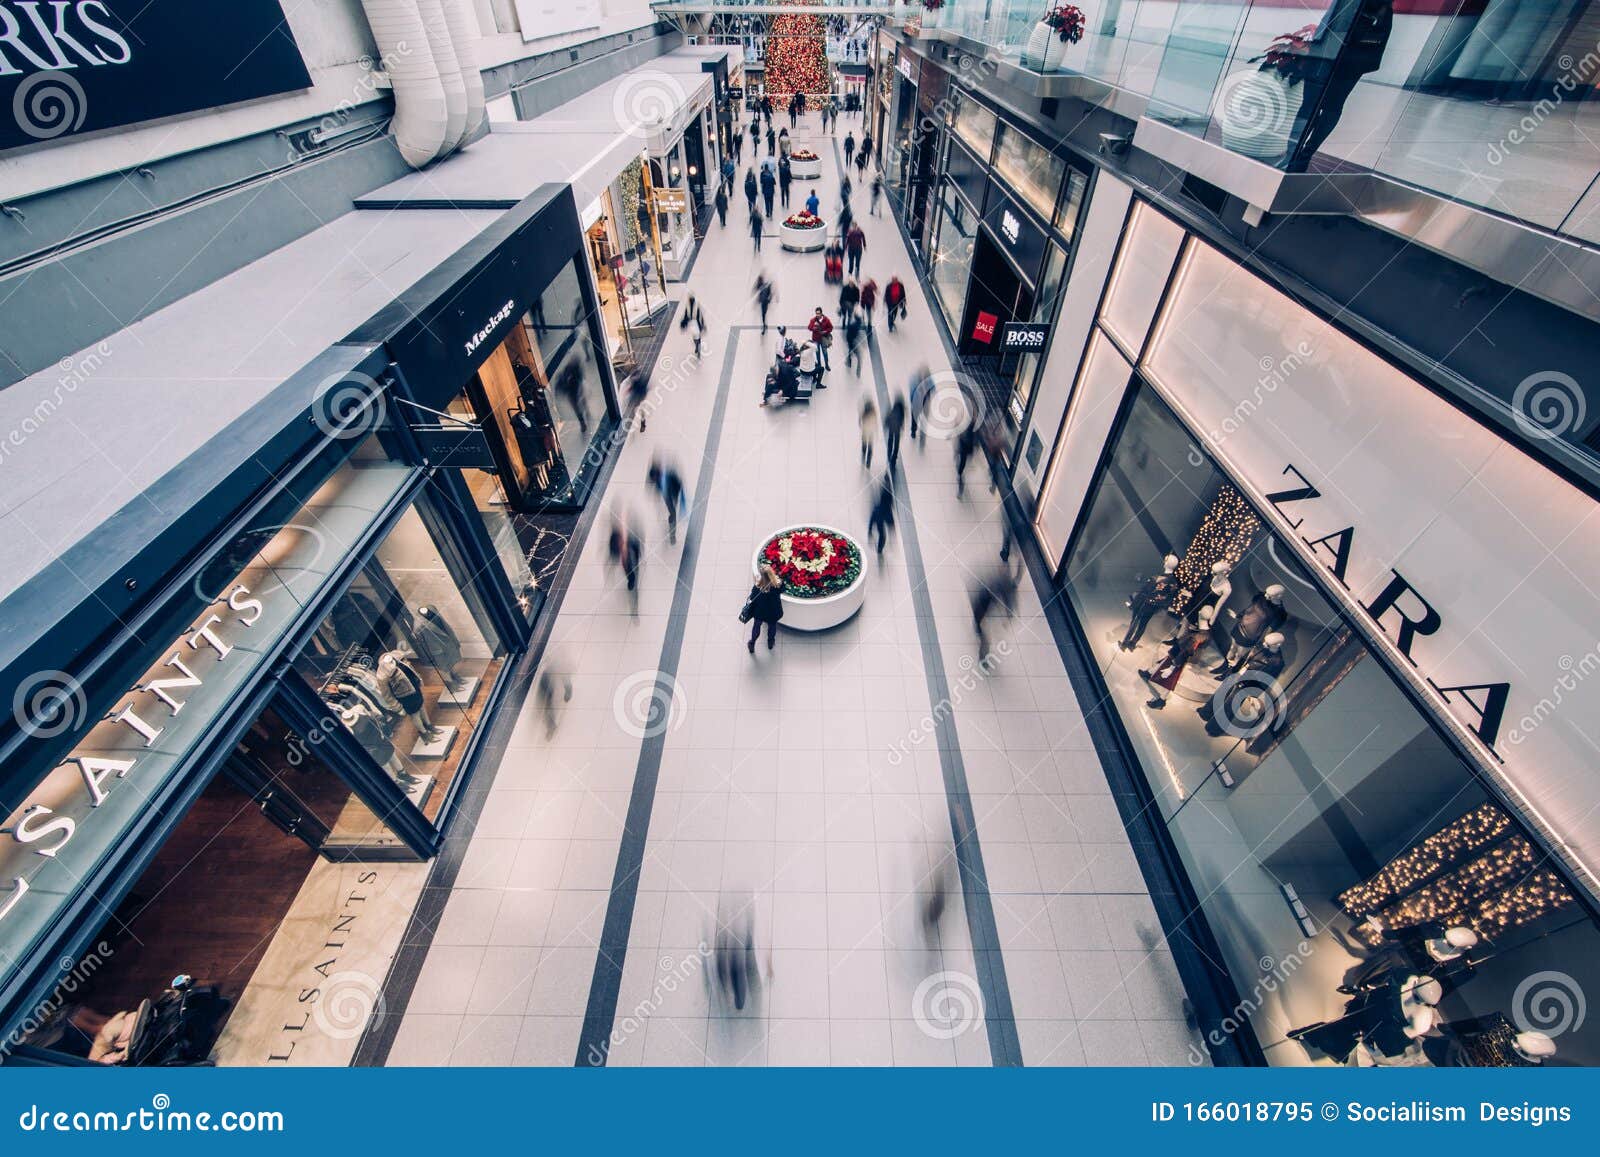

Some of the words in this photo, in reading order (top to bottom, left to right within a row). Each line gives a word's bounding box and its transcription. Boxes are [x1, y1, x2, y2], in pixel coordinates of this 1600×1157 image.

[464, 299, 514, 356] Mackage
[975, 321, 995, 334] SALE
[1005, 330, 1045, 342] BOSS
[1265, 463, 1511, 764] ZARA
